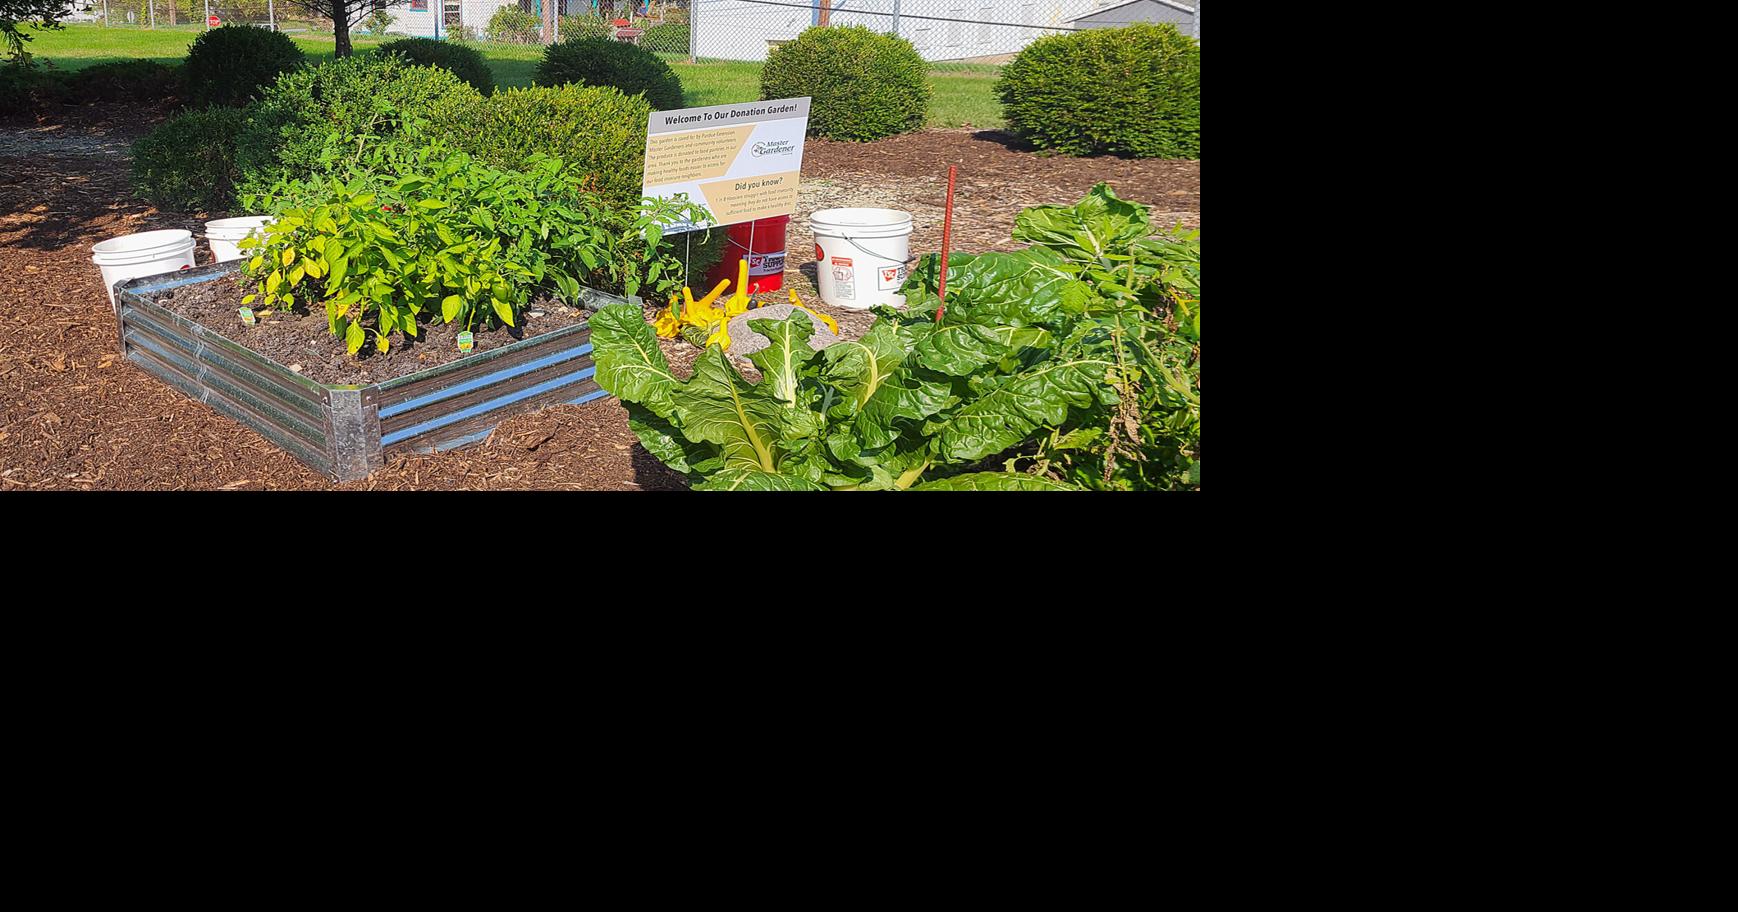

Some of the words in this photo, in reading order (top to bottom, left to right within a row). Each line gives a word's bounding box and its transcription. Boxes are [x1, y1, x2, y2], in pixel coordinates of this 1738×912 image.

[665, 115, 702, 125] Welcome
[704, 112, 712, 121] To
[714, 111, 728, 120] Our
[730, 107, 766, 118] Donation
[768, 104, 797, 114] Garden!
[760, 146, 795, 154] Gardener
[735, 182, 746, 190] Did
[748, 182, 760, 191] you
[762, 176, 783, 187] know?
